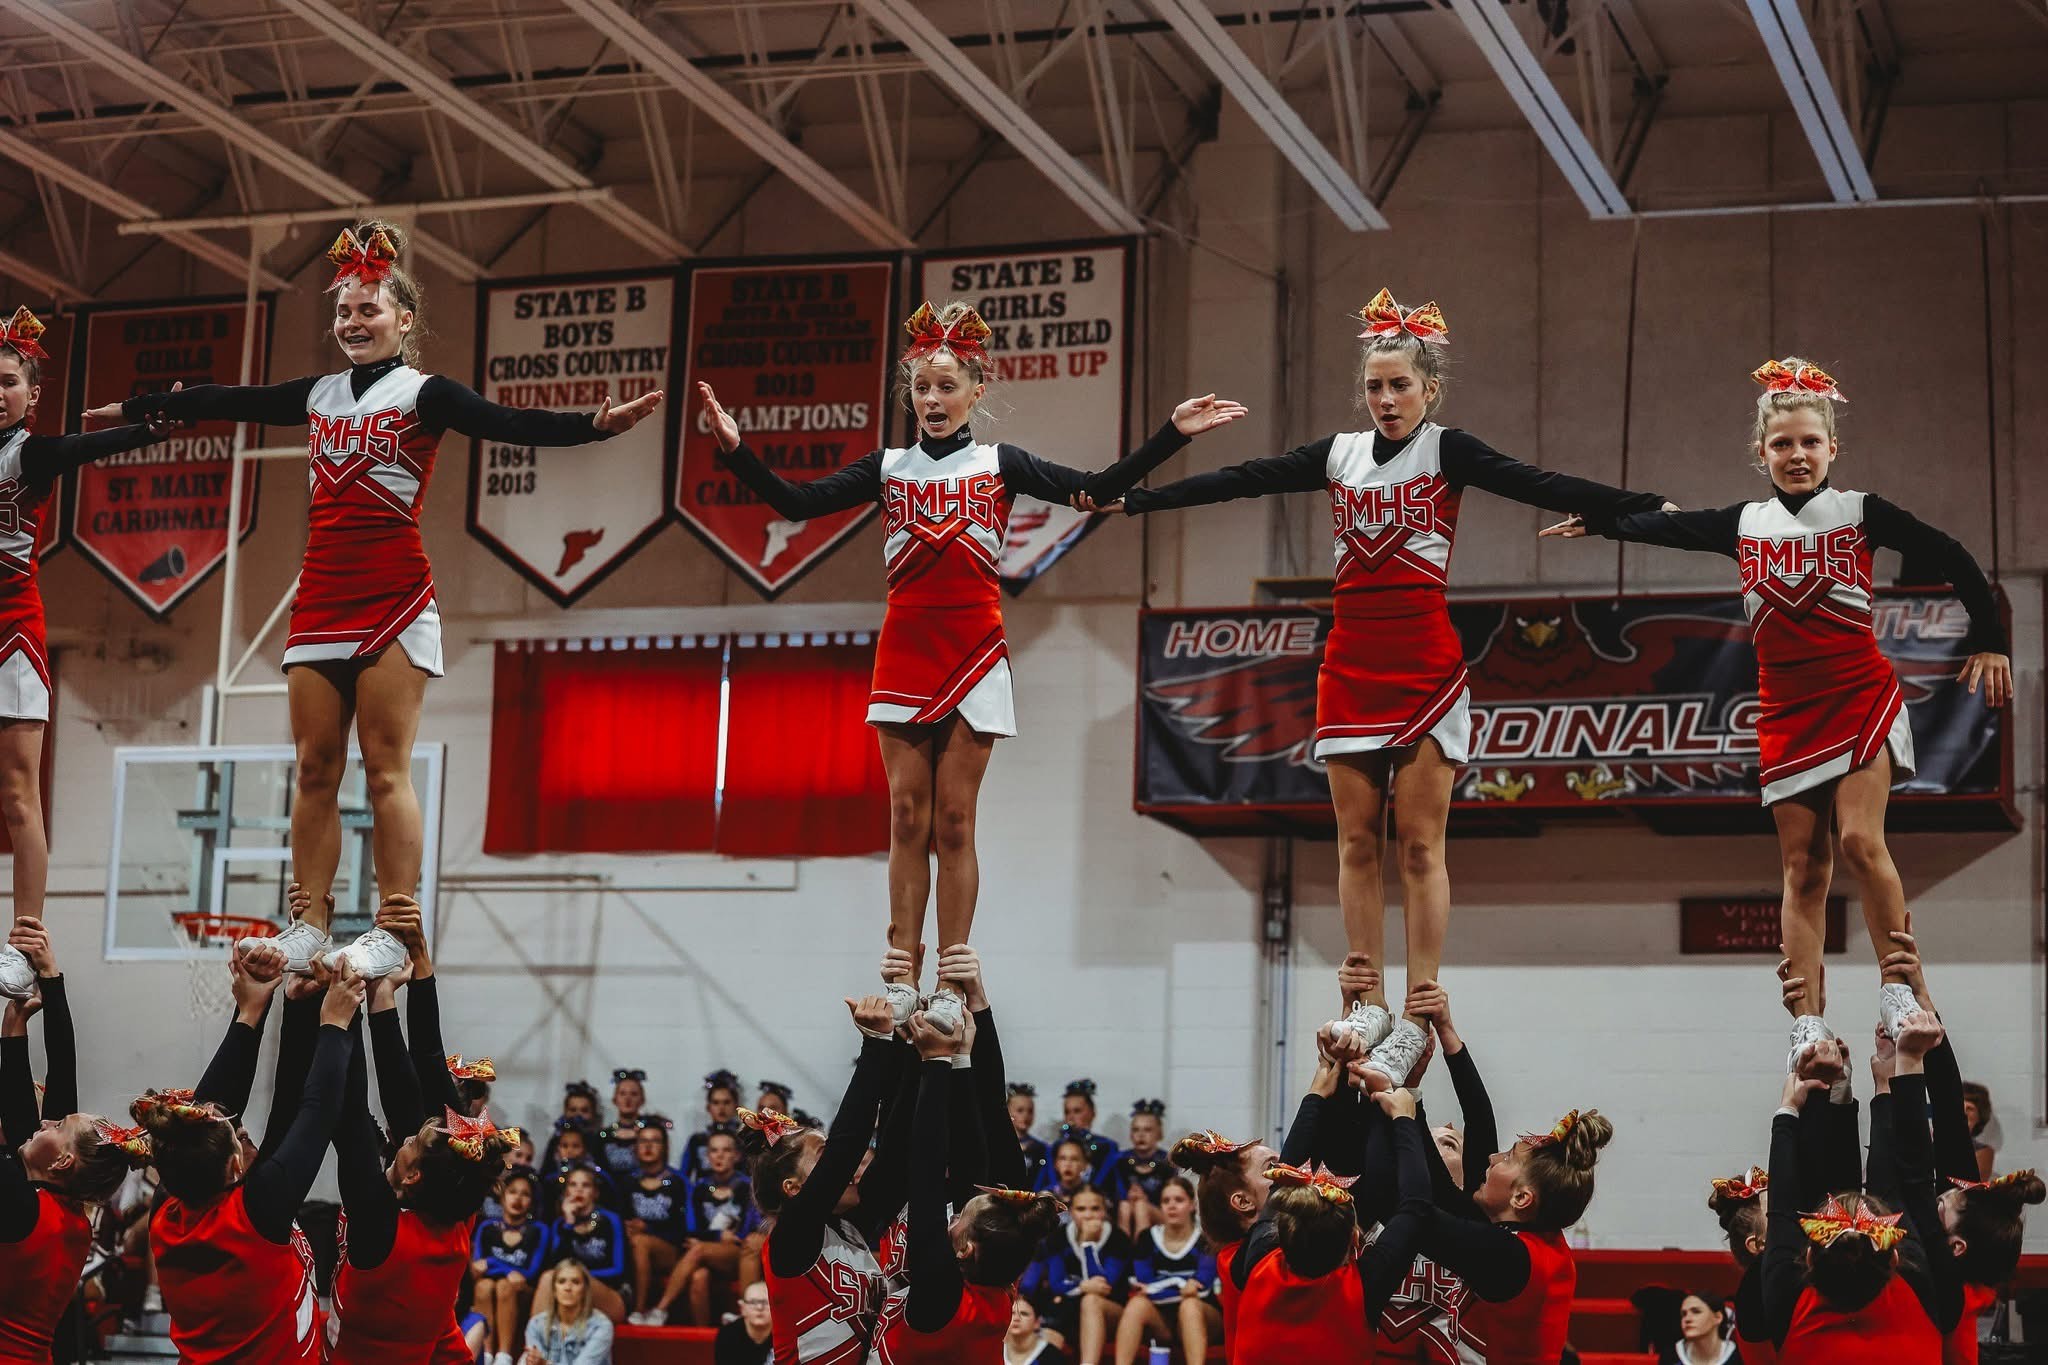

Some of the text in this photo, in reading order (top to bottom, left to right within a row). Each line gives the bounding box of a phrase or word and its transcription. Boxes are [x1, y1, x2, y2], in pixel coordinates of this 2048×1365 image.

[951, 256, 1095, 292] STATE B
[515, 285, 647, 319] STATE B
[977, 292, 1067, 319] GIRLS
[544, 320, 614, 348] BOYS
[1016, 324, 1036, 351] &
[1041, 318, 1112, 348] FIELD
[489, 346, 667, 382] CROSS COUNTRY
[1067, 350, 1108, 377] UP
[497, 377, 657, 409] RUNNER UP
[697, 402, 869, 434] CAMPIONS
[308, 406, 405, 469] SMHS
[151, 472, 227, 498] MARY
[487, 471, 537, 496] 2013
[885, 470, 995, 539] SMHS
[1330, 471, 1436, 542] SMHS
[1739, 523, 1858, 597] SMHS
[1872, 600, 1968, 640] THE
[1164, 617, 1319, 659] HOME
